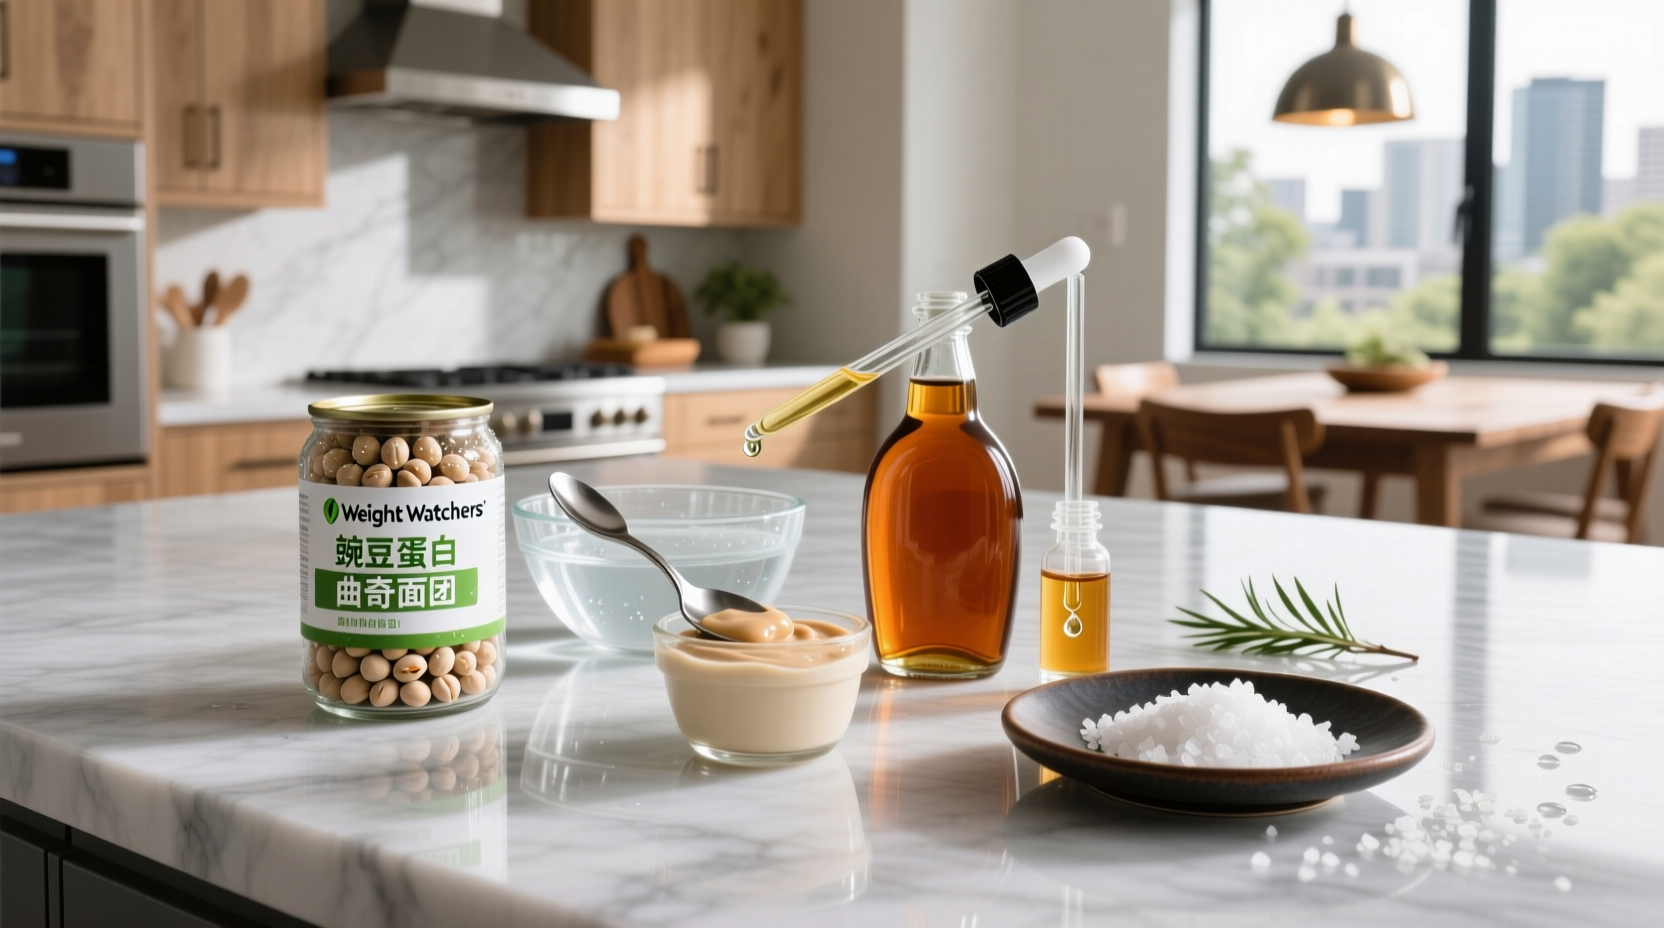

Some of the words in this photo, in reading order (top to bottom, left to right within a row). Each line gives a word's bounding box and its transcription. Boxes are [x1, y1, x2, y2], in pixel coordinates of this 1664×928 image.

[341, 503, 403, 528] Weight
[335, 534, 456, 568] 豌豆蛋白
[336, 575, 456, 609] 曲奇面团
